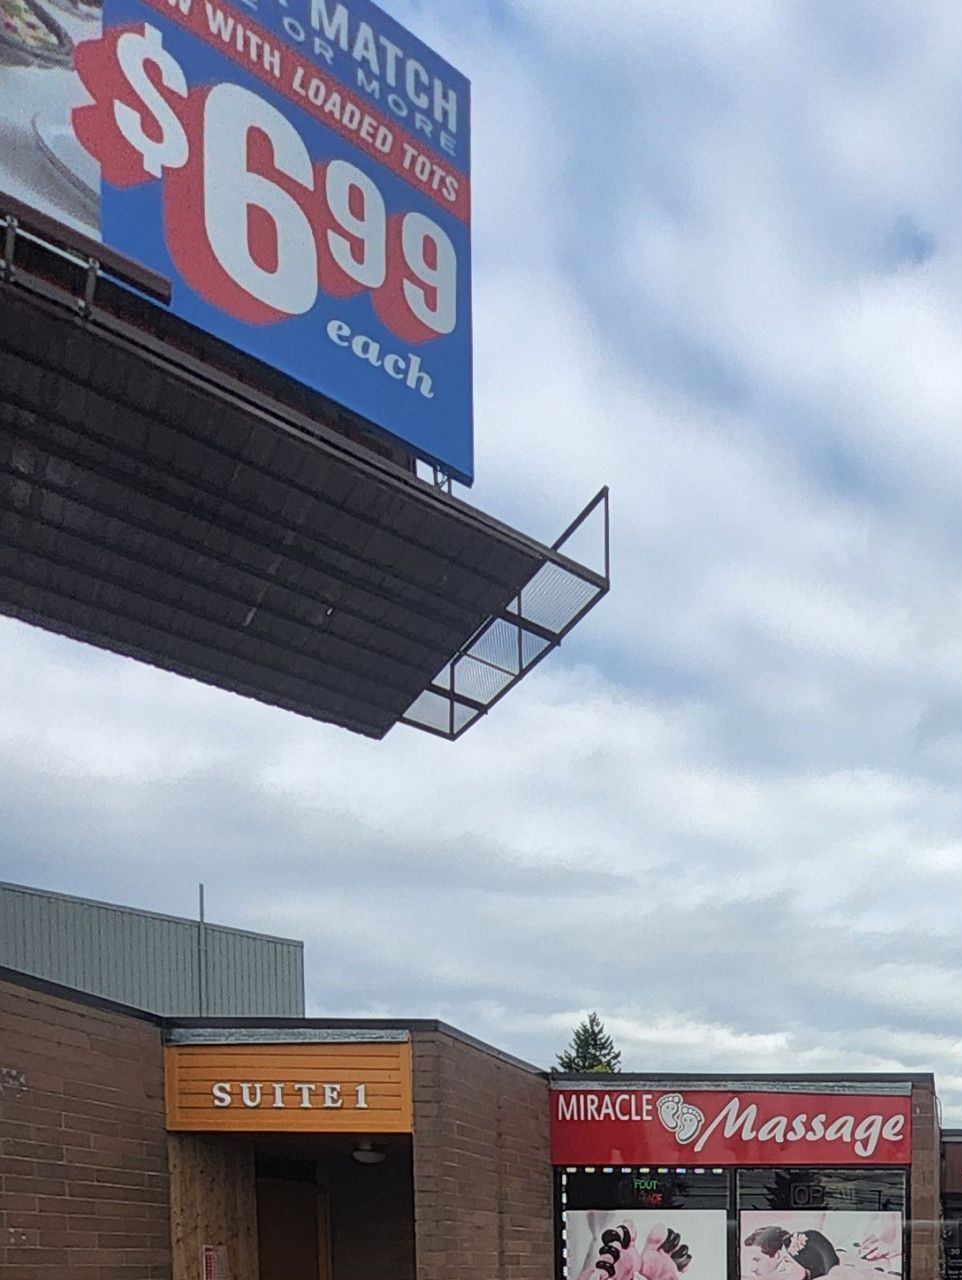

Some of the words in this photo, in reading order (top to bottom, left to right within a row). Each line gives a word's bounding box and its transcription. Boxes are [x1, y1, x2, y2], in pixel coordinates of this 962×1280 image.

[205, 1, 281, 78] WITH
[292, 67, 394, 154] LOADED
[402, 143, 458, 202] TOTS
[282, 16, 334, 64] OR
[357, 68, 457, 156] MORE
[311, 0, 457, 133] MATCH
[327, 318, 435, 399] each
[558, 1094, 652, 1121] MIRACLE
[693, 1097, 905, 1157] Massage
